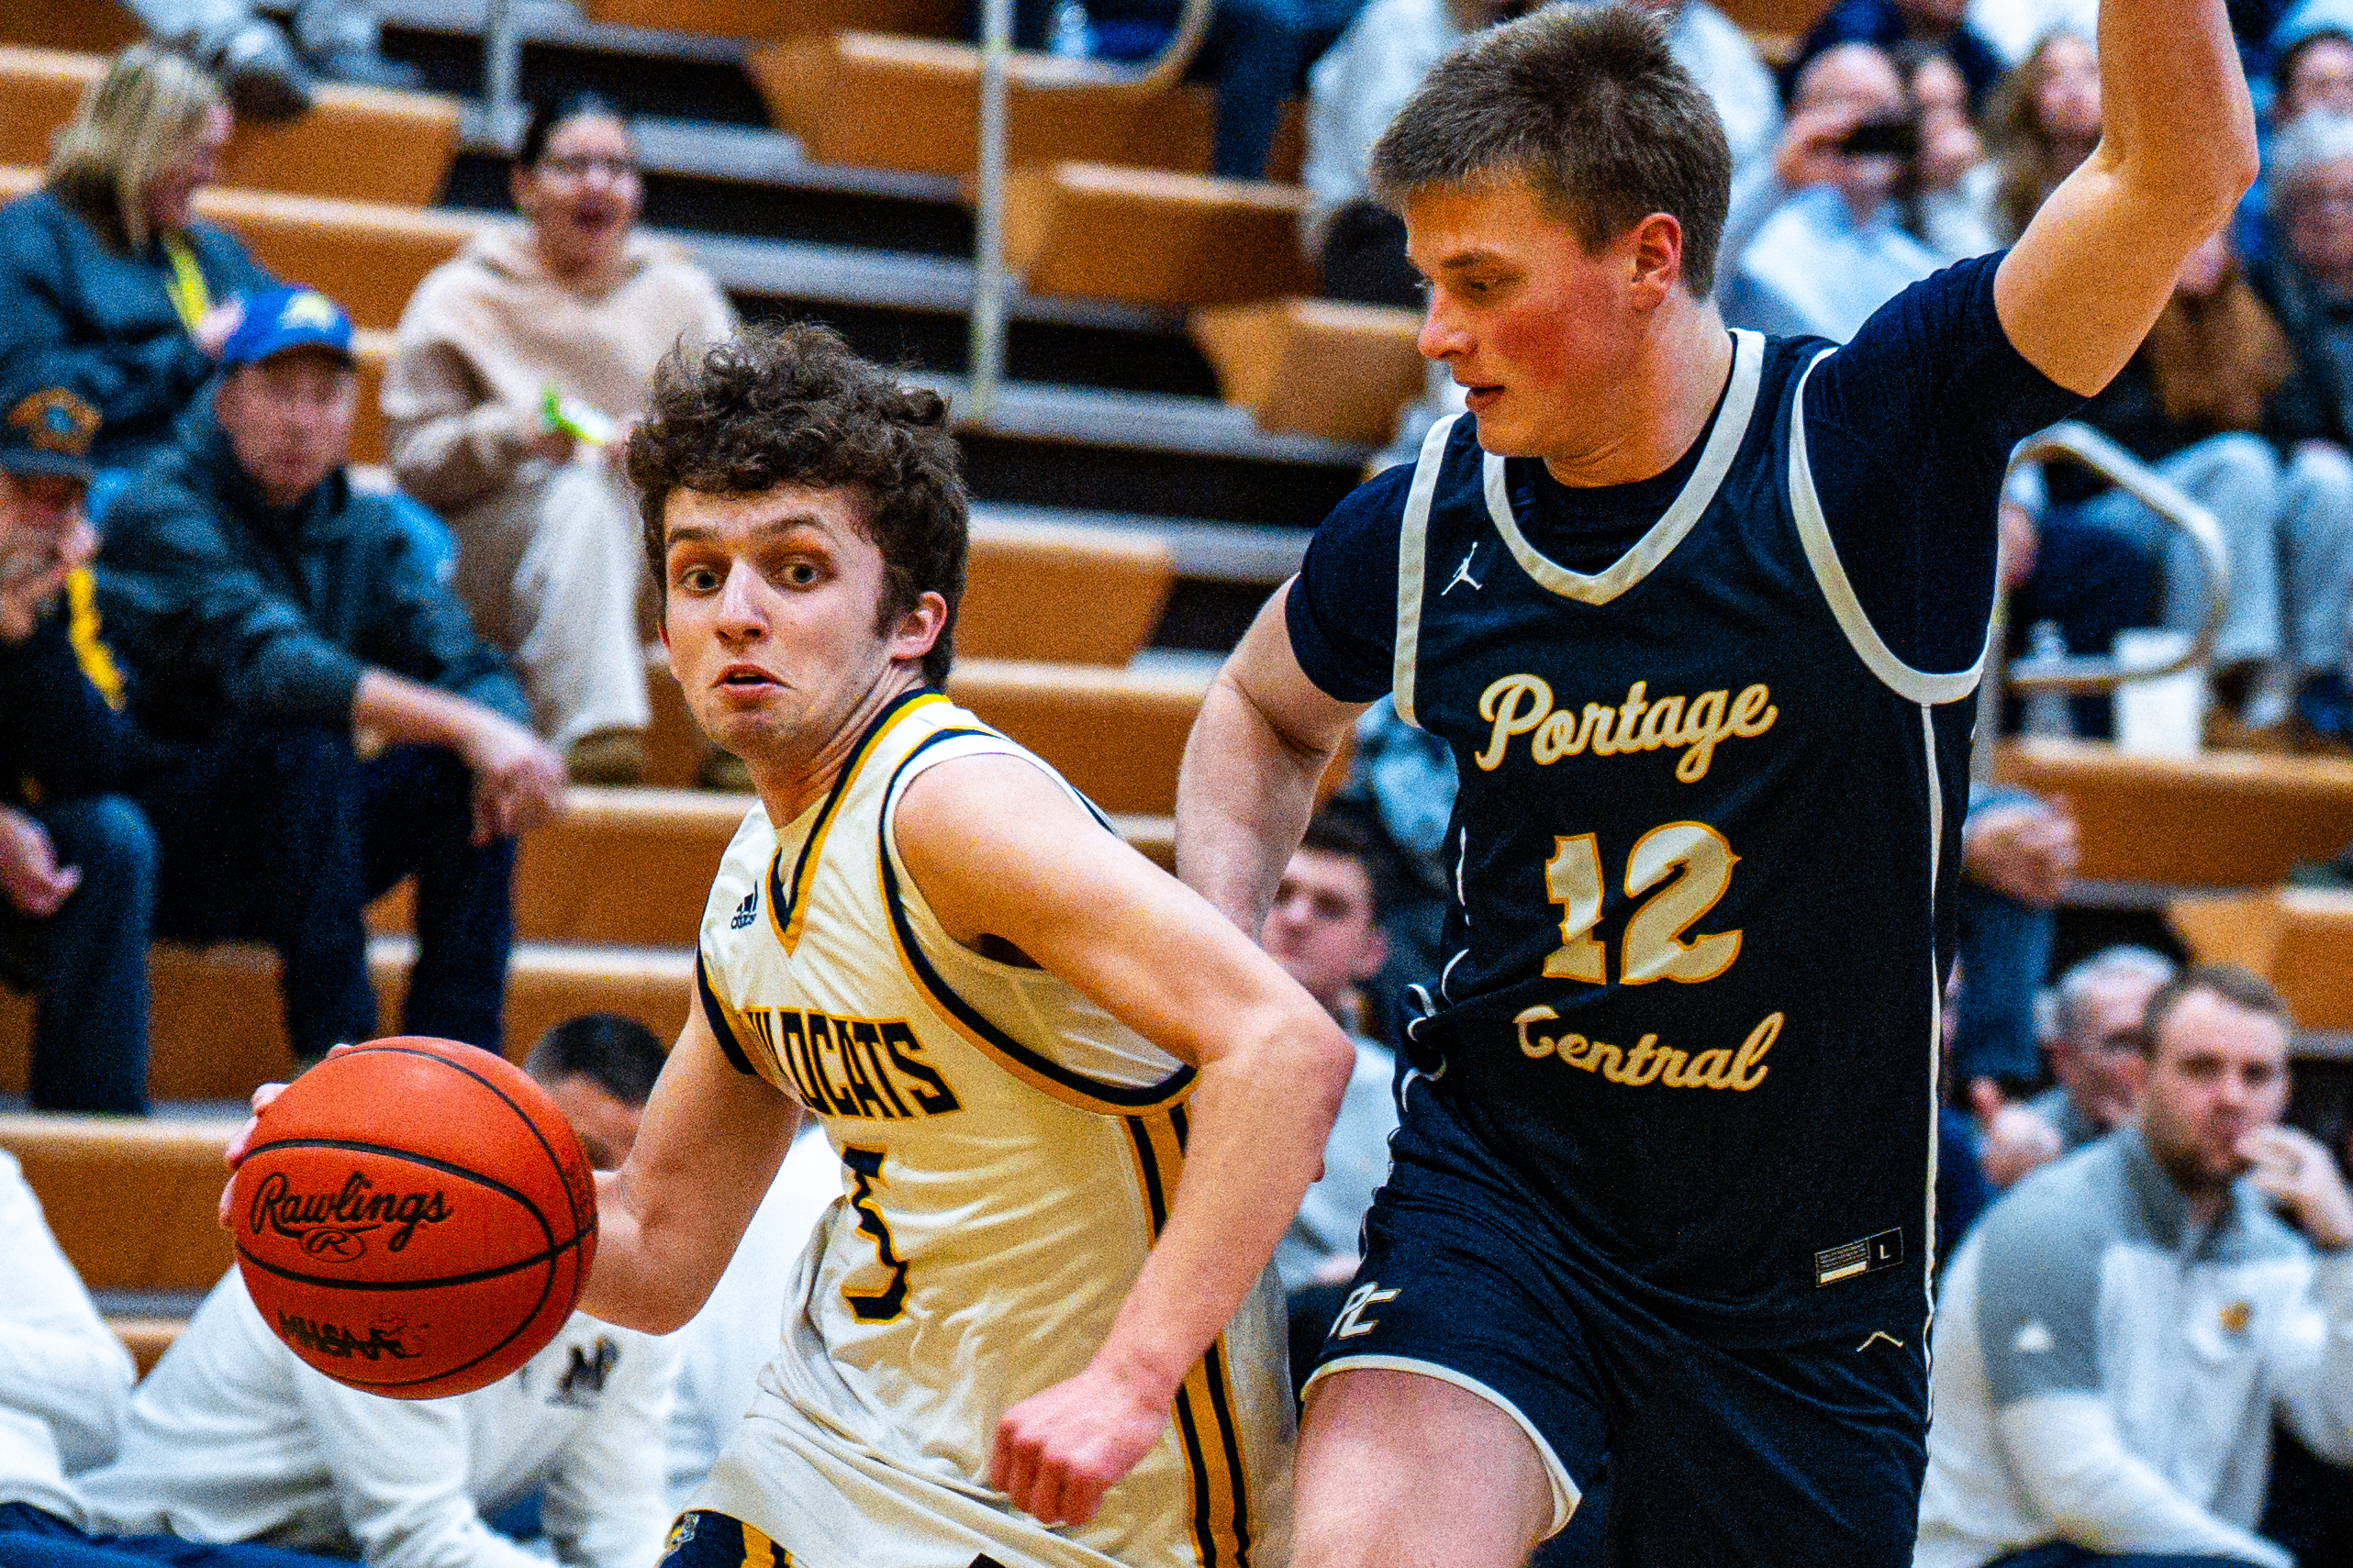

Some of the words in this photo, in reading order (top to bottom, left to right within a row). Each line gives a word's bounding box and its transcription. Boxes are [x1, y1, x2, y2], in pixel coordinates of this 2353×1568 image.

[1475, 673, 1779, 784] Portage
[1542, 820, 1743, 985] 12
[1512, 1005, 1785, 1092] Central
[250, 1172, 454, 1253] Rawlings
[1879, 1244, 1891, 1260] L
